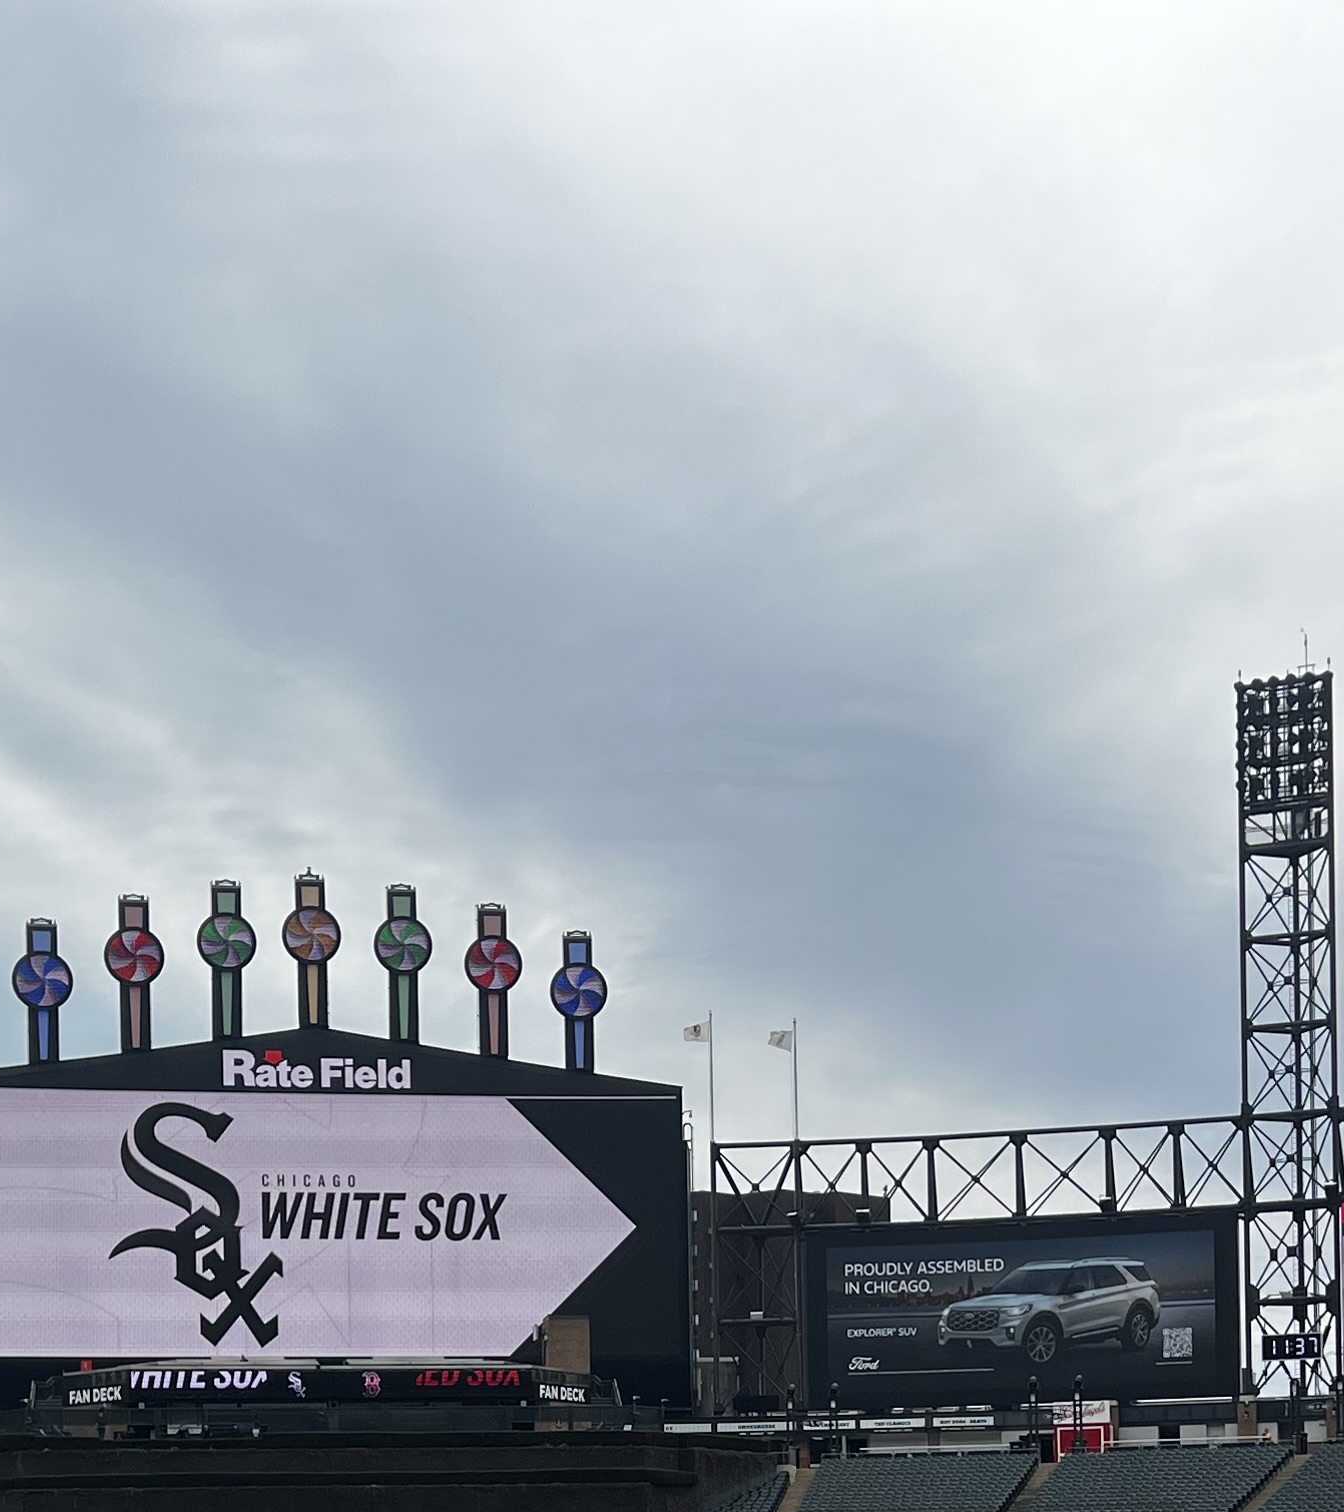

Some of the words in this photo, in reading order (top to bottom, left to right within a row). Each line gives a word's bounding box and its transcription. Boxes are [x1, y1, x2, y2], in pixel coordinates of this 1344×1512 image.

[222, 1049, 314, 1088] Rate
[320, 1057, 411, 1089] Field
[261, 1174, 356, 1187] CHICAGO
[261, 1192, 406, 1240] WHITE
[415, 1193, 509, 1241] SOX
[845, 1262, 913, 1277] PROUDLY
[917, 1258, 1004, 1274] ASSEMBLED
[845, 1282, 859, 1295] IN
[864, 1279, 933, 1294] CHICAGO.
[899, 1328, 917, 1336] SUV
[1273, 1338, 1317, 1355] 11:37
[849, 1357, 880, 1370] Ford
[69, 1389, 91, 1405] FAN
[92, 1386, 122, 1401] DECK
[539, 1385, 558, 1399] FAN
[560, 1387, 585, 1402] DECK
